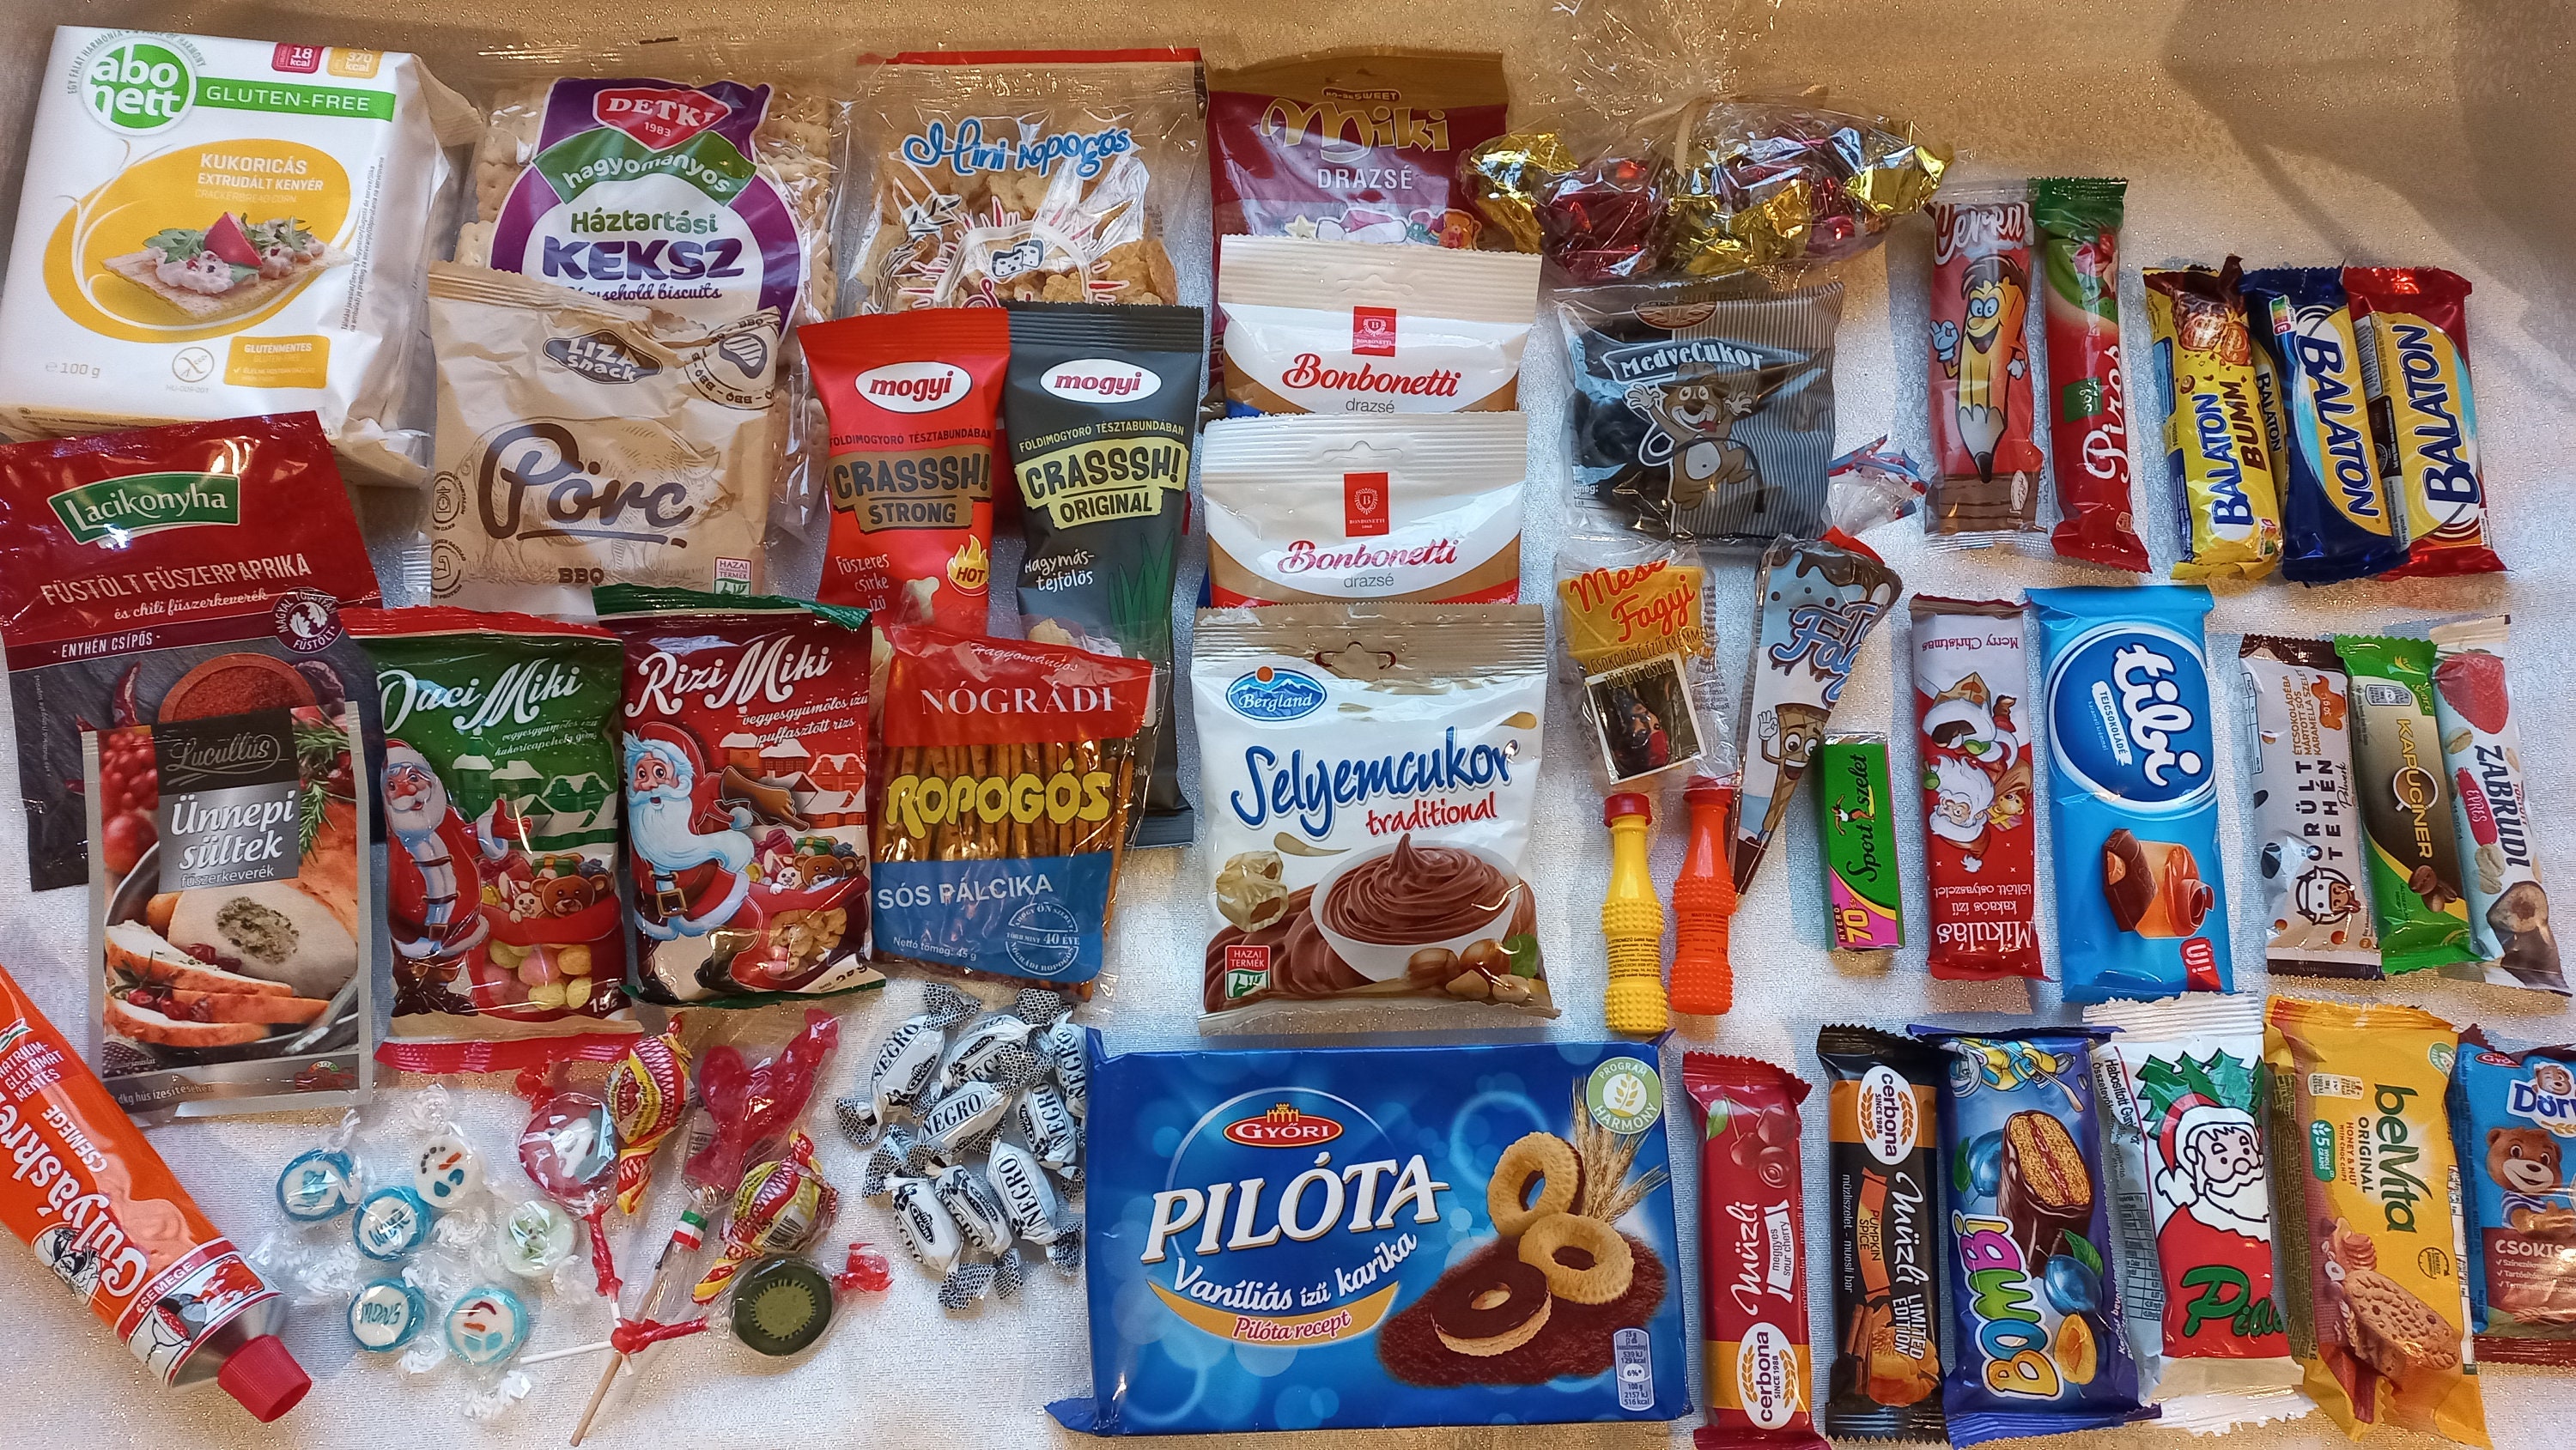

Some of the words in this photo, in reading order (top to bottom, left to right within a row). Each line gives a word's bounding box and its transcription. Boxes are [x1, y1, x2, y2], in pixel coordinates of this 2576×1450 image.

[91, 39, 179, 88] abo
[289, 58, 311, 69] kcal
[291, 46, 313, 60] 18
[344, 61, 370, 72] kcal
[206, 85, 371, 112] GLUTEN-FREE
[643, 120, 671, 137] 1983
[1260, 98, 1450, 164] Miki
[200, 151, 307, 175] KUKORICÁS
[562, 150, 731, 194] hagyományos
[1317, 165, 1413, 190] DRAZSÉ
[197, 172, 273, 191] EXTRUDÁLT
[275, 175, 324, 191] KENYÉR
[570, 207, 719, 234] Háztartási
[543, 234, 744, 282] KEKSZ
[658, 282, 723, 300] biscuits
[738, 318, 764, 329] BBQ
[244, 342, 313, 354] GLUTÉNMENTES
[568, 335, 641, 369] LIZA
[60, 361, 89, 375] 100
[91, 367, 101, 379] g
[868, 369, 955, 403] mogyi
[1054, 370, 1143, 396] mogyi
[1282, 353, 1462, 397] Bonbonetti
[725, 391, 753, 404] BBQ
[1345, 397, 1395, 414] drazsé
[2391, 324, 2482, 505] BALATON
[829, 434, 905, 449] FÖLDIMOGYORÓ
[908, 427, 993, 444] TÉSZTABUNDÁBAN
[1018, 424, 1093, 453] FÖLDIMOGYORÓ
[1096, 419, 1185, 436] TÉSZTABUNDÁBAN
[2218, 380, 2268, 472] BUMM
[2297, 334, 2381, 519] BALATON
[1024, 444, 1181, 501] CRASSSH!
[2191, 392, 2255, 526] BALATON
[477, 421, 695, 540] Pörc
[833, 453, 991, 500] CRASSSH!
[64, 482, 229, 531] Lacikonyha
[870, 502, 957, 525] STRONG
[1060, 490, 1153, 524] ORIGINAL
[1349, 517, 1385, 525] BONBONETTI
[720, 560, 748, 569] HAZAI
[1277, 537, 1459, 574] Bonbonetti
[39, 571, 142, 606] FÜSTÖLT
[144, 552, 313, 592] FŰSZERPAPRIKA
[558, 567, 605, 585] BBQ
[854, 574, 890, 592] csirke
[956, 566, 985, 583] HOT
[1036, 570, 1094, 594] tejfölös
[1343, 572, 1394, 589] drazsé
[114, 608, 131, 621] és
[132, 601, 167, 618] chili
[167, 587, 269, 616] fűszerkeverék
[275, 598, 295, 634] MAGYAL
[1610, 573, 1696, 643] Fagyi
[61, 639, 108, 658] ENYHÉN
[111, 631, 155, 651] CSÍPŐS
[969, 641, 1080, 673] Hagyományos
[1922, 636, 1983, 652] Christmas
[1985, 633, 2020, 650] Merry
[624, 652, 728, 718] Rizi
[704, 634, 834, 709] Miki
[1589, 644, 1643, 674] CSOKOLÁDÉ
[1603, 670, 1643, 690] TÖLTÖTT
[1645, 658, 1674, 677] OSTYA
[452, 658, 584, 731] Miki
[920, 680, 1115, 717] NÓGRÁDI
[2293, 690, 2305, 709] SÓS
[2296, 668, 2312, 698] SZELET
[742, 695, 848, 727] vegyesgyümölcs
[1239, 692, 1314, 715] Bergland
[2281, 675, 2303, 755] ÉTCSOKOLÁDÉBA
[756, 721, 830, 748] puffasztott
[832, 718, 856, 731] rizs
[2099, 690, 2129, 755] TEJCSOKOLÁDÉ
[2297, 710, 2313, 755] MÁRTOTT
[2306, 701, 2322, 755] KARAMELLA
[1230, 725, 1518, 838] Selyemcukor
[1847, 753, 1871, 807] szelet
[2396, 718, 2433, 859] KAPUCINER
[170, 789, 296, 836] Ünnepi
[885, 758, 1114, 840] ROPOGÓS
[1364, 791, 1498, 837] traditional
[2317, 759, 2343, 861] TEHÉN
[2465, 789, 2488, 822] EPRES
[2474, 744, 2531, 868] ZABRUDI
[179, 829, 283, 871] sültek
[1845, 822, 1882, 883] Sport
[878, 883, 933, 911] SÓS
[939, 872, 1054, 906] PÁLCIKA
[1933, 882, 1995, 899] ostyaszelet
[1973, 900, 2017, 915] kakaós
[893, 936, 919, 951] Nettó
[920, 941, 957, 958] tömeg:
[957, 947, 969, 960] 45
[969, 951, 978, 962] g
[1042, 932, 1060, 945] 40
[1061, 934, 1080, 946] ÉVE
[1936, 920, 2033, 953] Mikulás
[1230, 956, 1266, 969] TERMÉK
[1233, 949, 1262, 960] HAZAI
[874, 1022, 920, 1082] NEGRO
[14, 1068, 62, 1103] MENTES
[1598, 1060, 1649, 1080] PROGRAM
[118, 1095, 134, 1106] dkg
[135, 1091, 151, 1102] hús
[1880, 1072, 1899, 1158] cerbona
[922, 1093, 982, 1139] NEGRO
[1031, 1081, 1071, 1152] NEGRO
[1235, 1118, 1332, 1144] GYŐRI
[1593, 1102, 1659, 1132] HARMONY
[40, 1104, 108, 1174] CSEMEGE
[2315, 1136, 2330, 1147] 5
[2345, 1121, 2355, 1156] HONEY
[2357, 1116, 2374, 1194] ORIGINAL
[2372, 1083, 2434, 1234] belVita
[998, 1156, 1047, 1226] NEGRO
[2348, 1166, 2358, 1187] NUT
[1141, 1150, 1451, 1265] PILÓTA
[1841, 1173, 1852, 1229] müzliszelet
[1780, 1221, 1792, 1254] cherry
[1859, 1217, 1869, 1251] SPICE
[1869, 1207, 1882, 1262] PUMPKIN
[1892, 1170, 1930, 1284] Müzli
[1725, 1200, 1759, 1317] Müzli
[1771, 1228, 1783, 1272] meggyes
[1783, 1254, 1793, 1277] sour
[1843, 1239, 1853, 1276] muesli
[136, 1260, 196, 1313] CSEMEGE
[1171, 1257, 1294, 1312] Vaníliás
[1299, 1286, 1333, 1312] ízű
[1334, 1232, 1419, 1297] karika
[1844, 1277, 1854, 1294] bar
[1232, 1312, 1294, 1341] Pilóta
[1294, 1310, 1352, 1340] recept
[1892, 1298, 1909, 1355] EDITION
[1908, 1294, 1927, 1360] LIMITED
[1756, 1330, 1773, 1423] cerbona
[1772, 1372, 1782, 1399] SINCE
